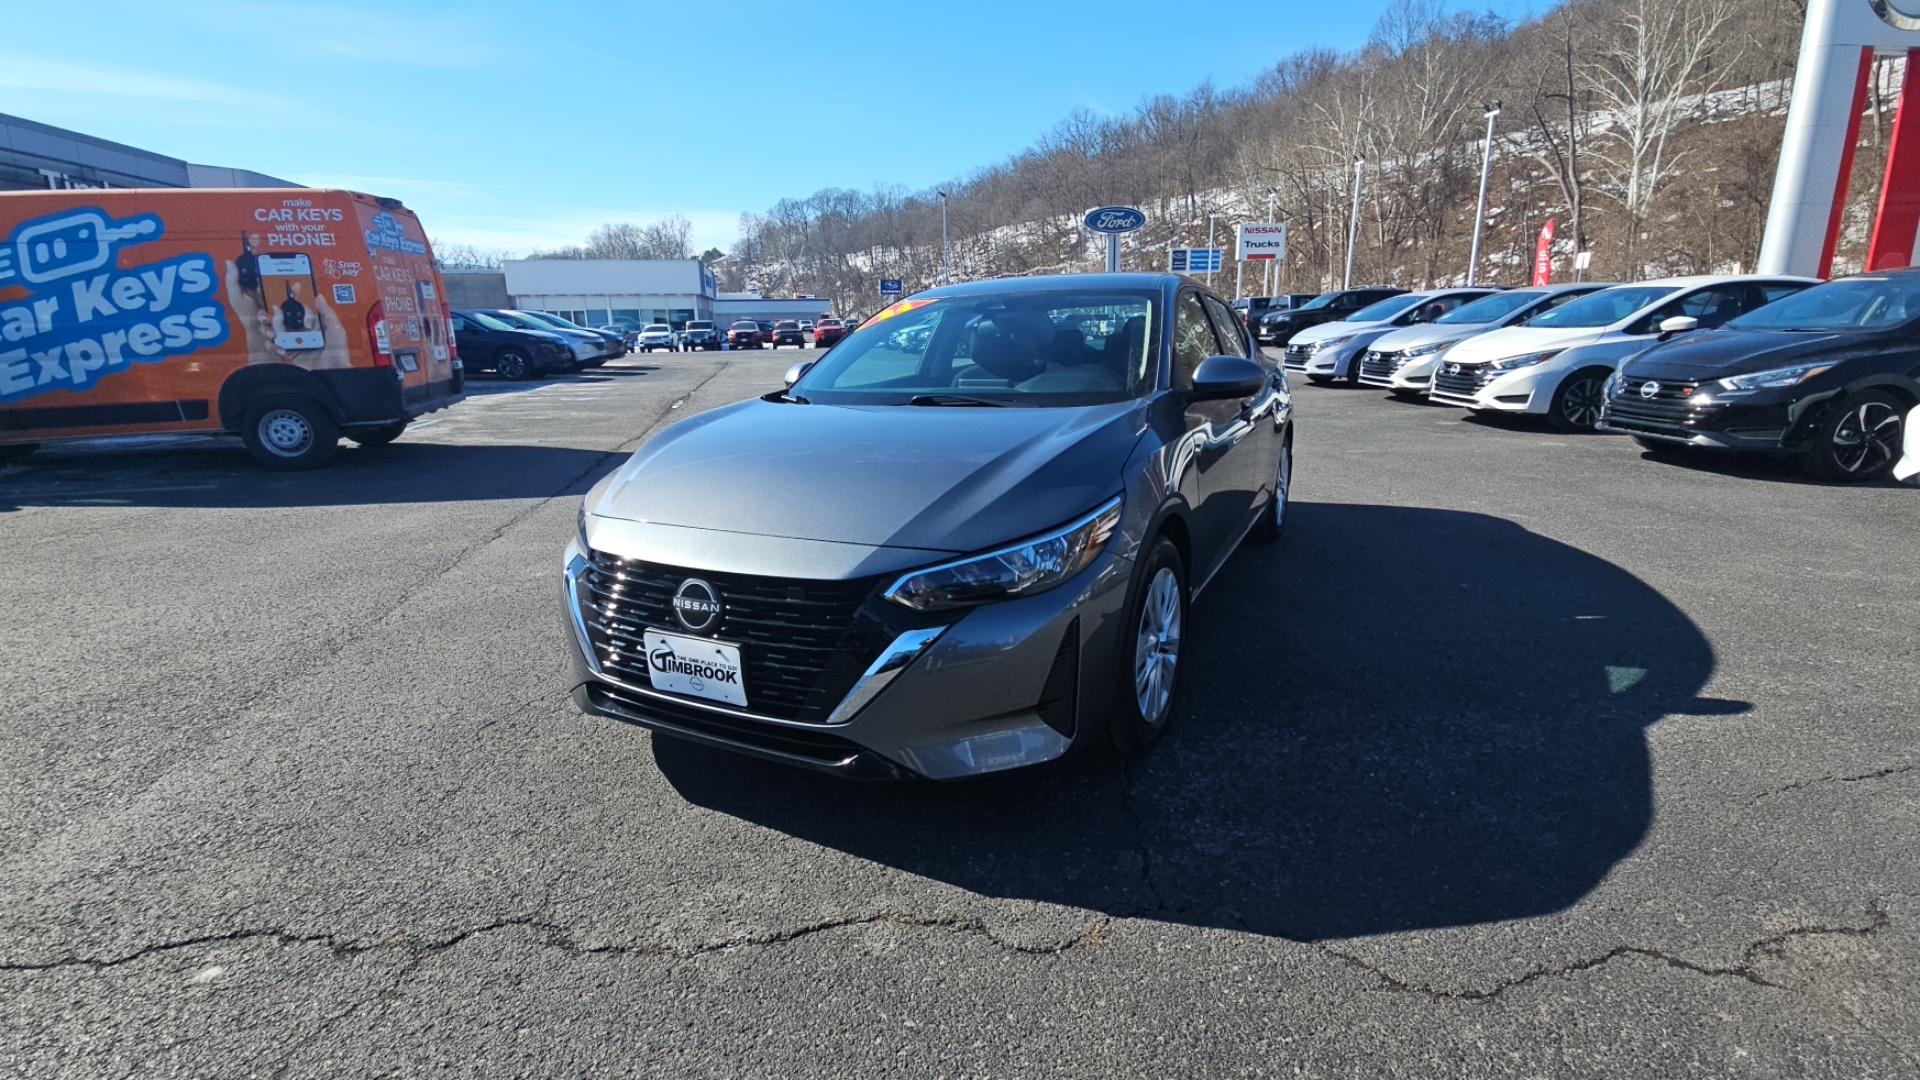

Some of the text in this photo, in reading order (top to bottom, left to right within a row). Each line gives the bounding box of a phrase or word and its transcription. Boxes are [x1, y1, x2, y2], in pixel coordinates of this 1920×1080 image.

[283, 199, 311, 207] make
[254, 209, 343, 221] CAR KEYS
[1097, 211, 1136, 229] Ford
[276, 223, 325, 232] with your
[267, 233, 336, 246] PHONE!
[1245, 240, 1280, 248] Trucks
[374, 265, 391, 281] CAR
[391, 267, 411, 283] KEYS
[0, 259, 211, 342] ar Keys
[0, 306, 222, 395] Express
[673, 597, 720, 613] NISSAN
[655, 651, 738, 685] TIMBROOK
[701, 659, 718, 667] PLACE
